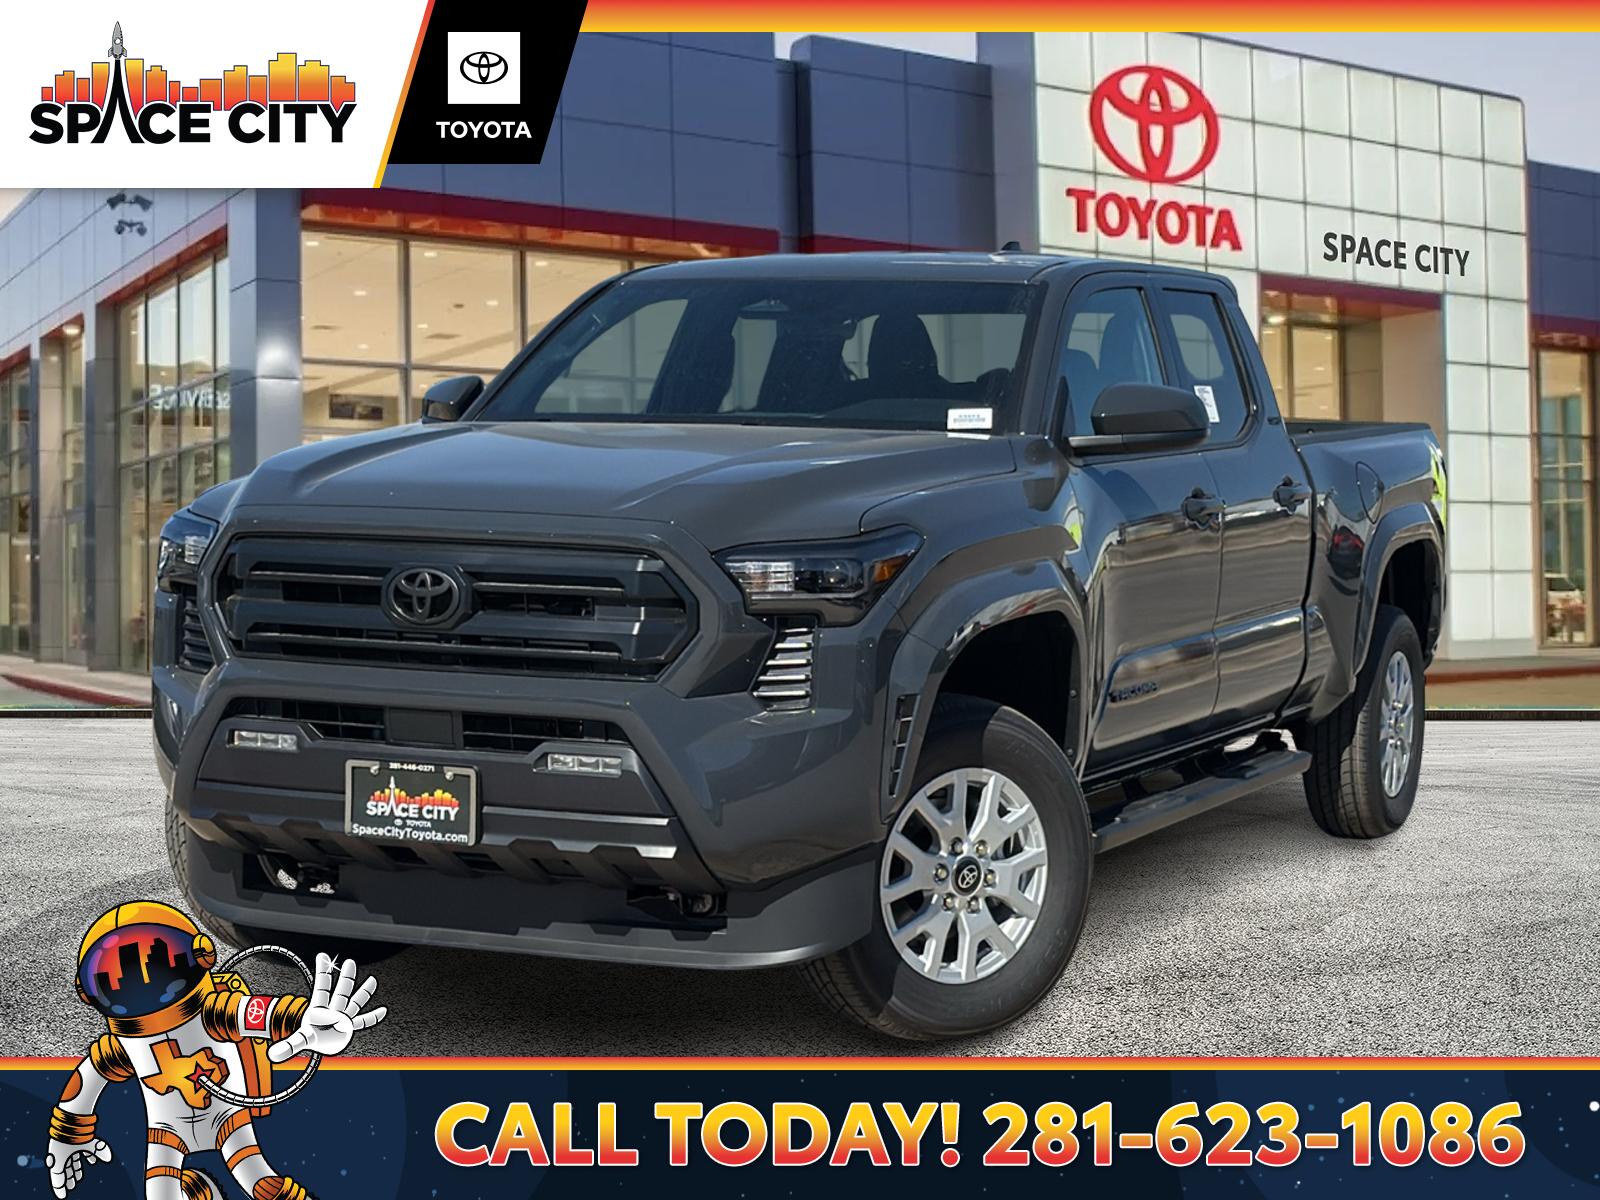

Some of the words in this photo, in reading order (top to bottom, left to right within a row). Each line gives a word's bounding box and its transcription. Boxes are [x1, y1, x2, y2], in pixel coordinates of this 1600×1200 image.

[1066, 187, 1243, 251] TOYOTA
[1323, 231, 1406, 270] SPACE
[1414, 244, 1470, 277] CITY
[422, 804, 460, 821] CITY
[352, 823, 468, 843] SpaceCityToyota.com
[405, 819, 432, 828] TOYOTA
